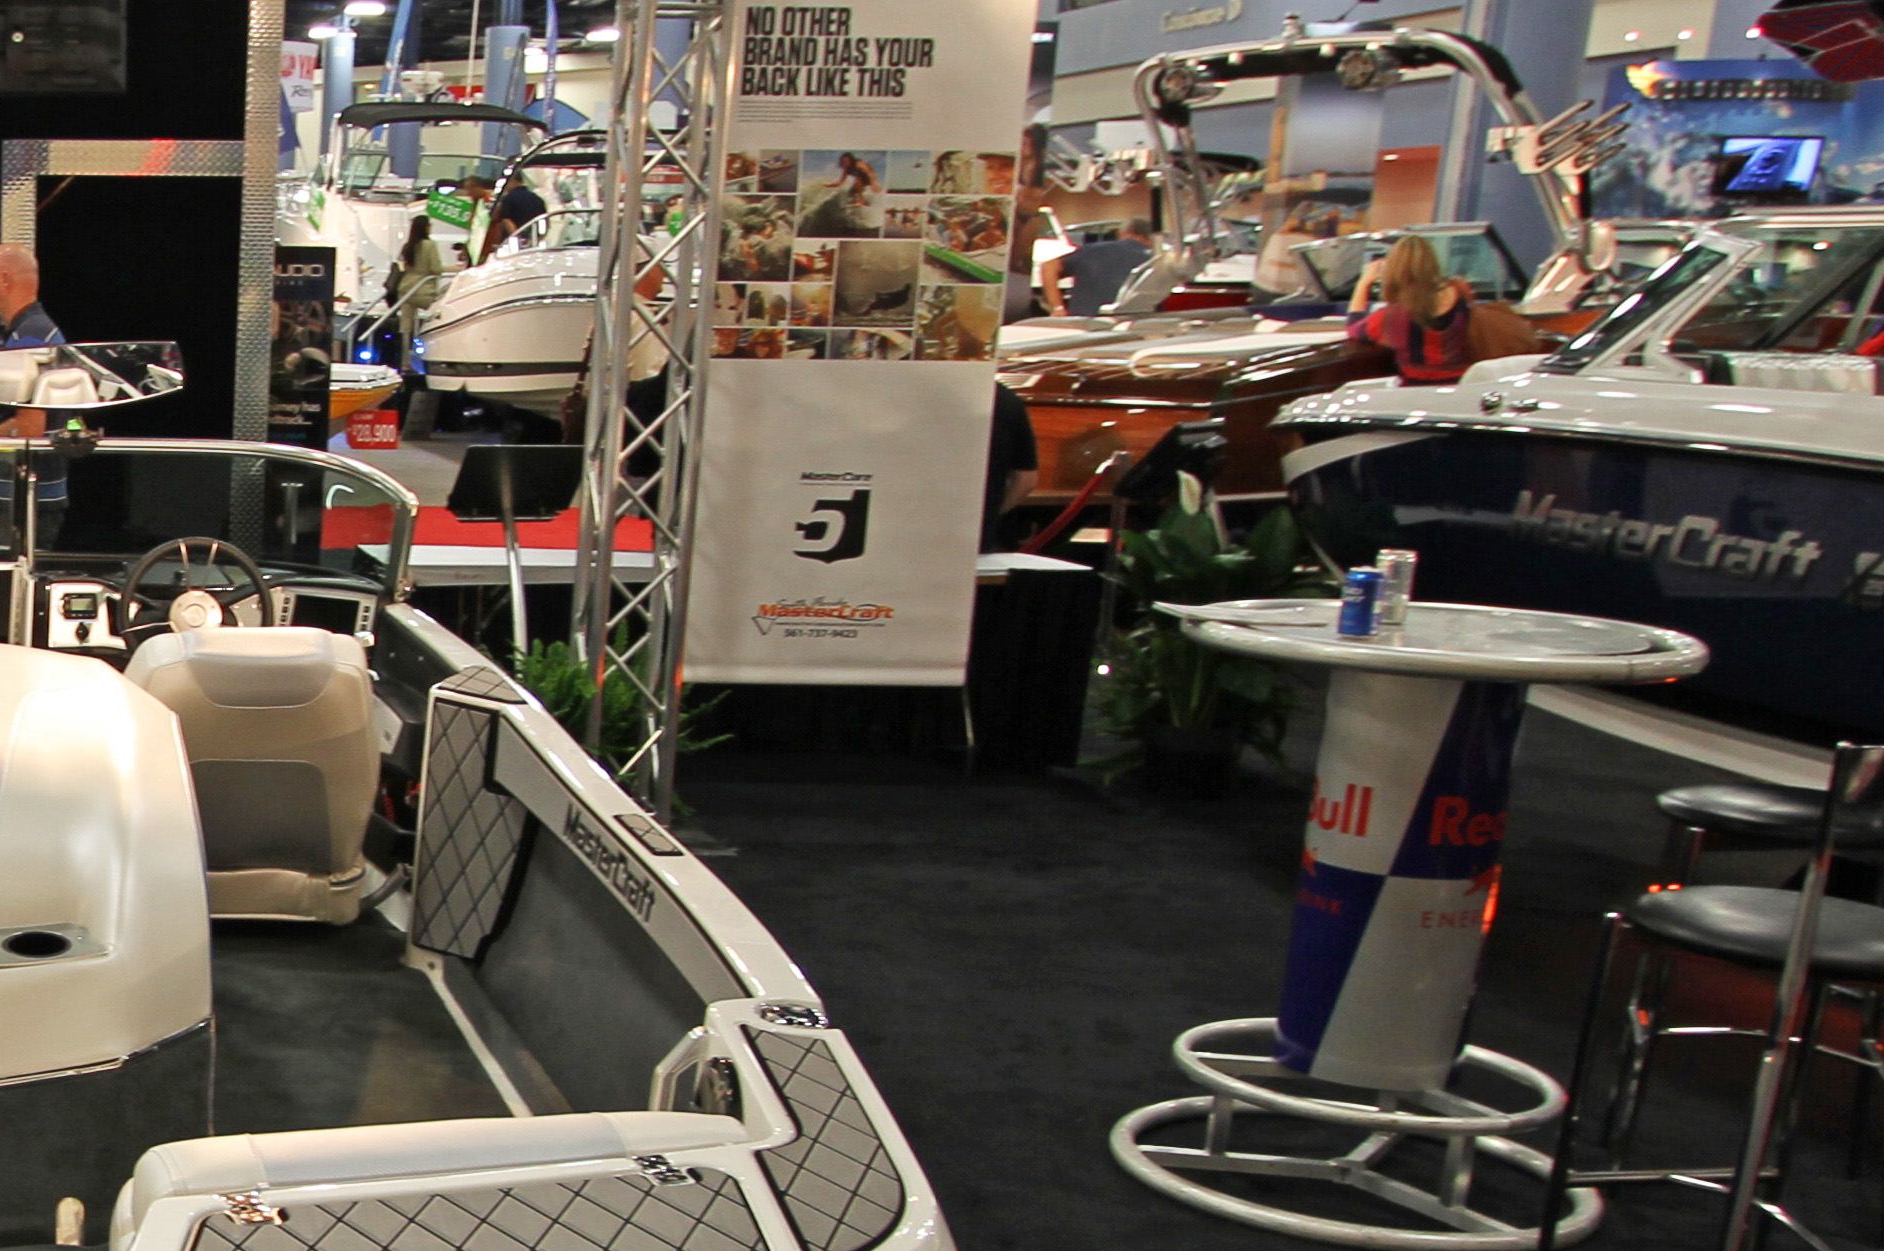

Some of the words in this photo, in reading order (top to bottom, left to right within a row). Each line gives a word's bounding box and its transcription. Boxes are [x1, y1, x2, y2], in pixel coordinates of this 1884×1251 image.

[746, 6, 776, 36] NO
[781, 6, 851, 37] OTHER
[743, 36, 818, 67] BRAND
[823, 37, 869, 67] HAS
[874, 37, 935, 68] YOUR
[740, 66, 801, 96] BACK
[805, 67, 851, 97] LIKE
[856, 67, 907, 98] THIS
[1512, 490, 1825, 581] MasterCraft
[758, 603, 896, 620] MasterCraft
